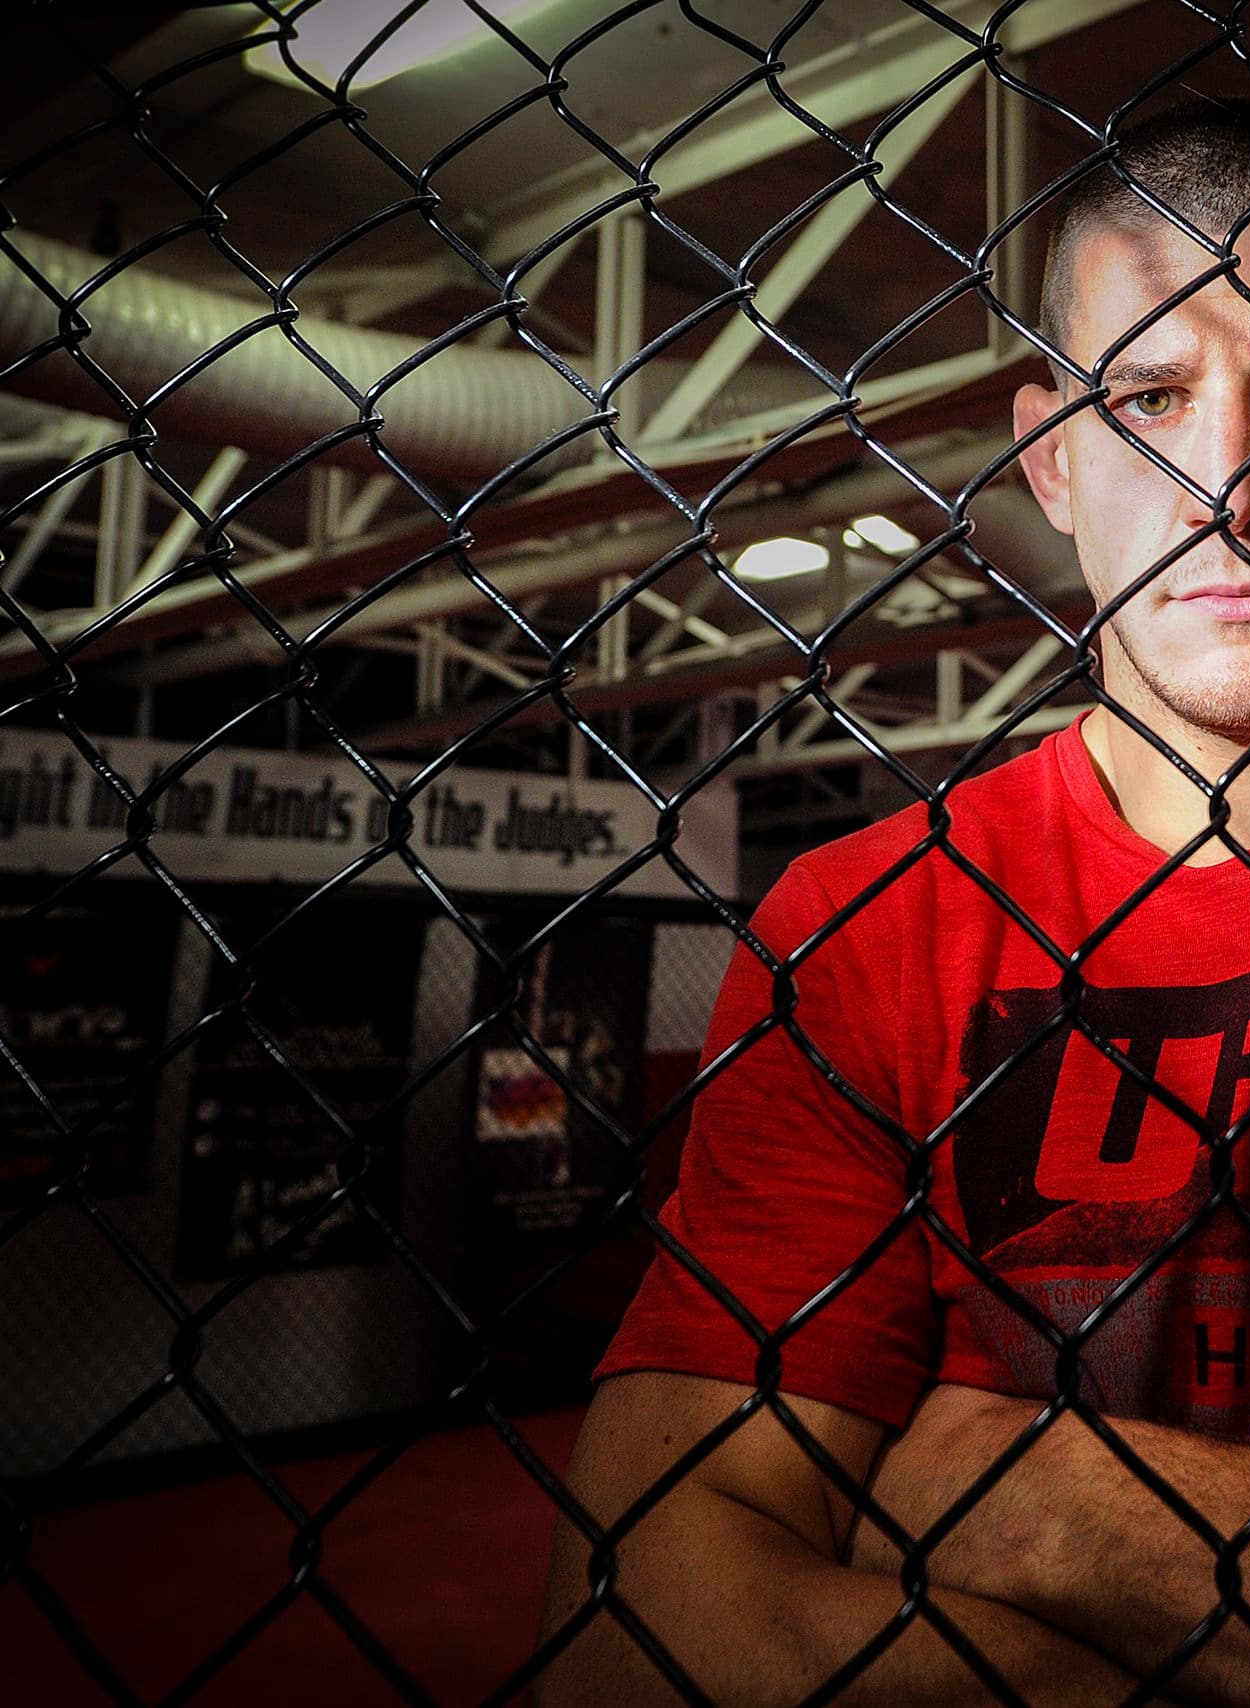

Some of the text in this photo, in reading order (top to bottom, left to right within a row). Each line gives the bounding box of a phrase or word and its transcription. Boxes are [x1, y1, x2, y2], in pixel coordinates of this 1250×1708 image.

[226, 766, 352, 841] Hands
[426, 784, 484, 847] the
[496, 787, 626, 865] Judges.
